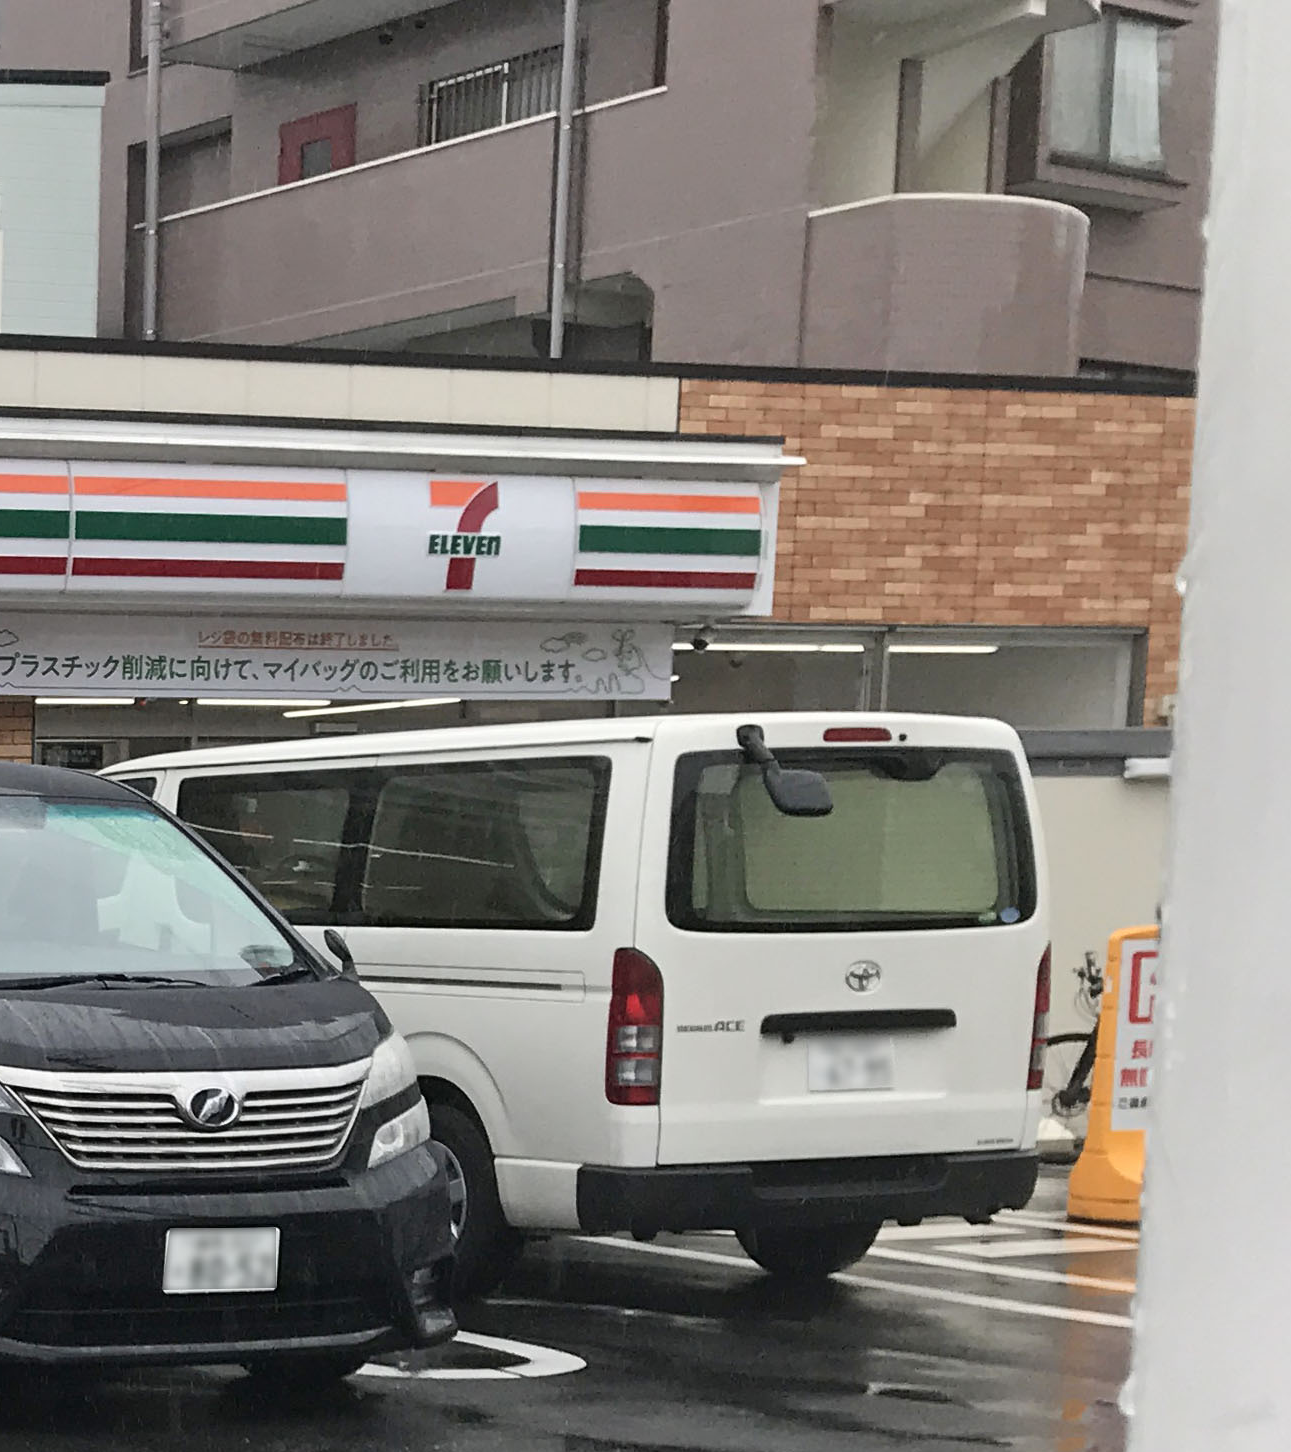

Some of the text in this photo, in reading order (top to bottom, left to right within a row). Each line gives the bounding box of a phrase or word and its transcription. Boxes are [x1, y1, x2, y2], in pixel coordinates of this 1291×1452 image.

[0, 652, 583, 685] プラスチック削減に向けて、マイバッグのご利用をお願いします。
